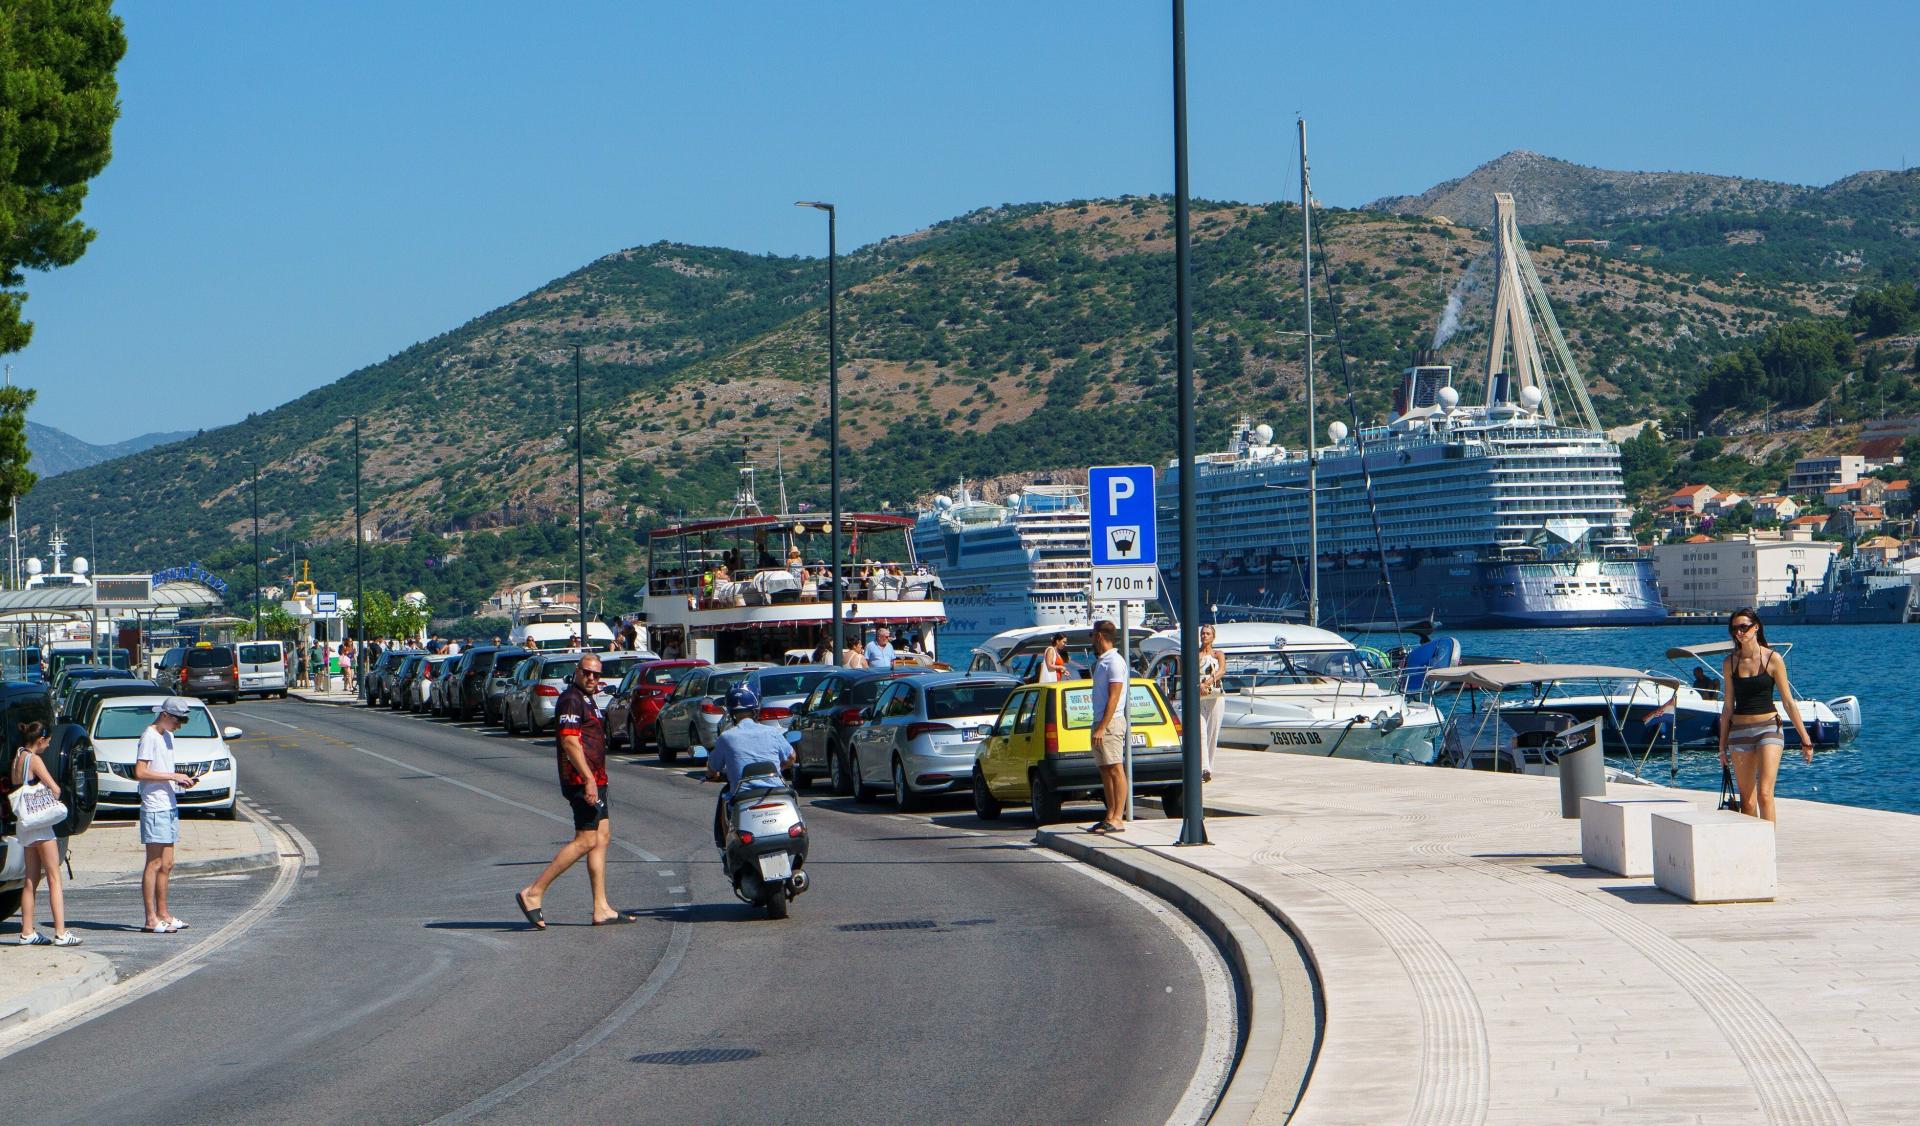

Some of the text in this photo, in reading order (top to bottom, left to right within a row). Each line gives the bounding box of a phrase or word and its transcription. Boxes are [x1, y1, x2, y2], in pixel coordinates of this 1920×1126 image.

[1108, 476, 1135, 516] P
[1106, 576, 1143, 590] 700 m
[1270, 731, 1322, 745] 269750 DB
